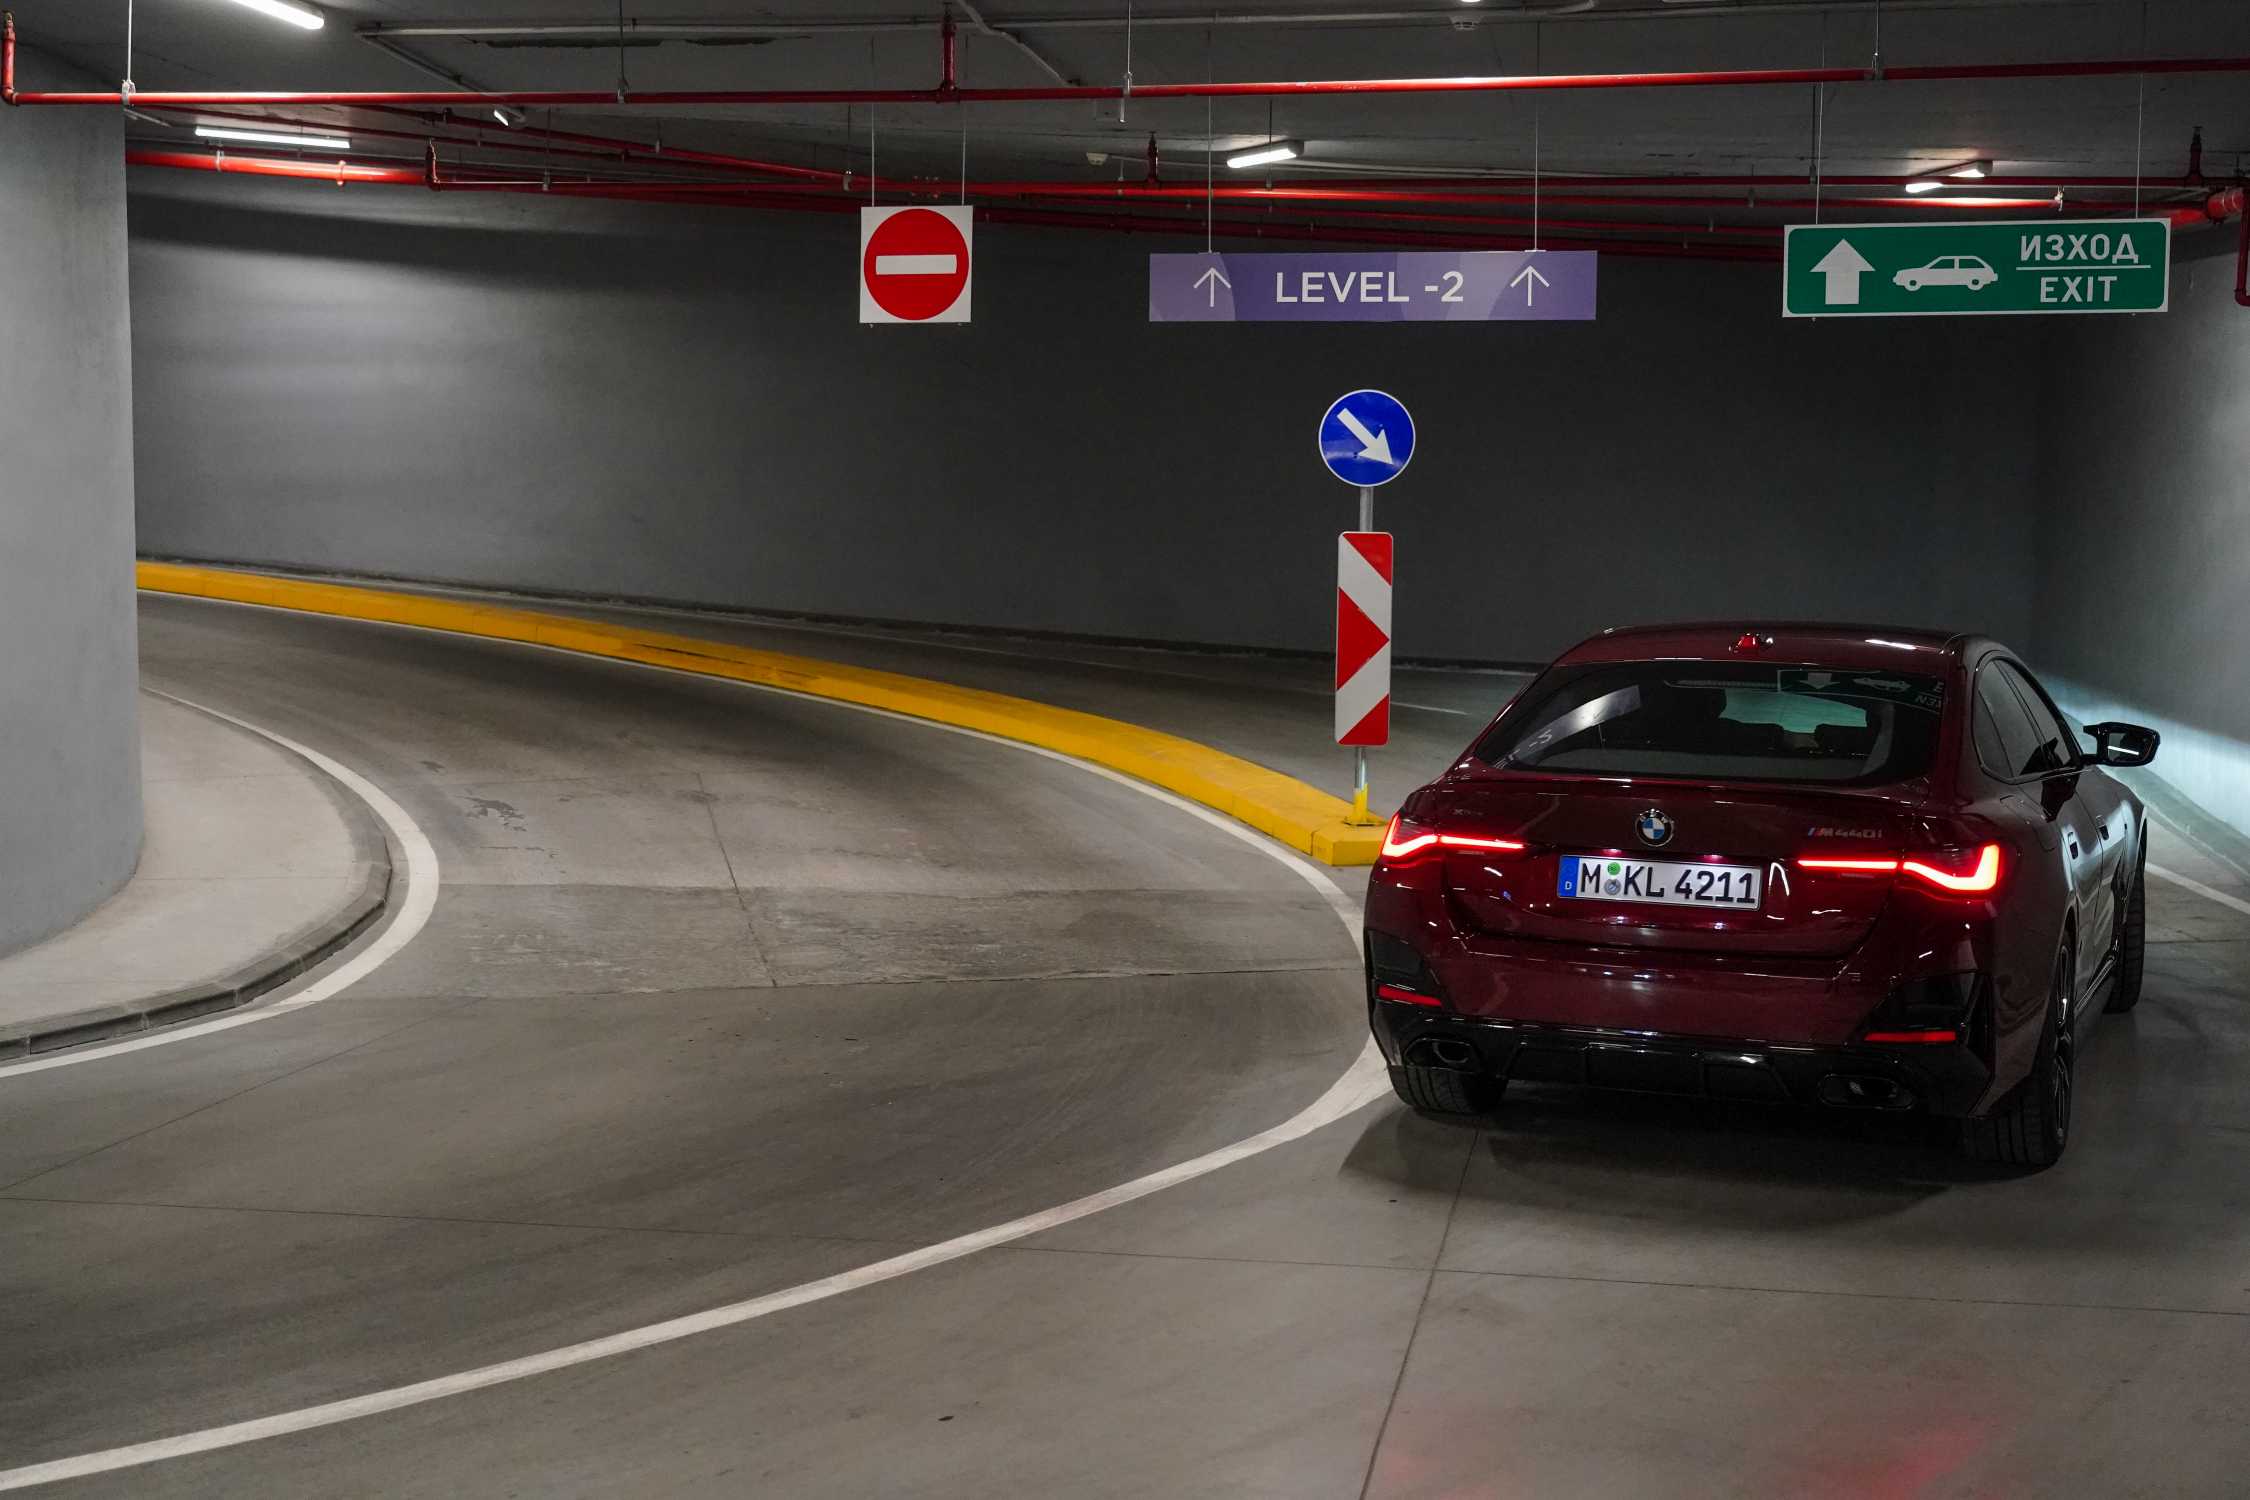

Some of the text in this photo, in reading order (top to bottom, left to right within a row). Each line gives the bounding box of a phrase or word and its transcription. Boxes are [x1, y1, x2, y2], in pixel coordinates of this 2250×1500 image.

[2020, 233, 2139, 264] ИЗХОД
[1275, 270, 1464, 303] LEVEL -2
[2040, 275, 2118, 303] EXIT
[1564, 863, 1755, 903] D M KL 4211
